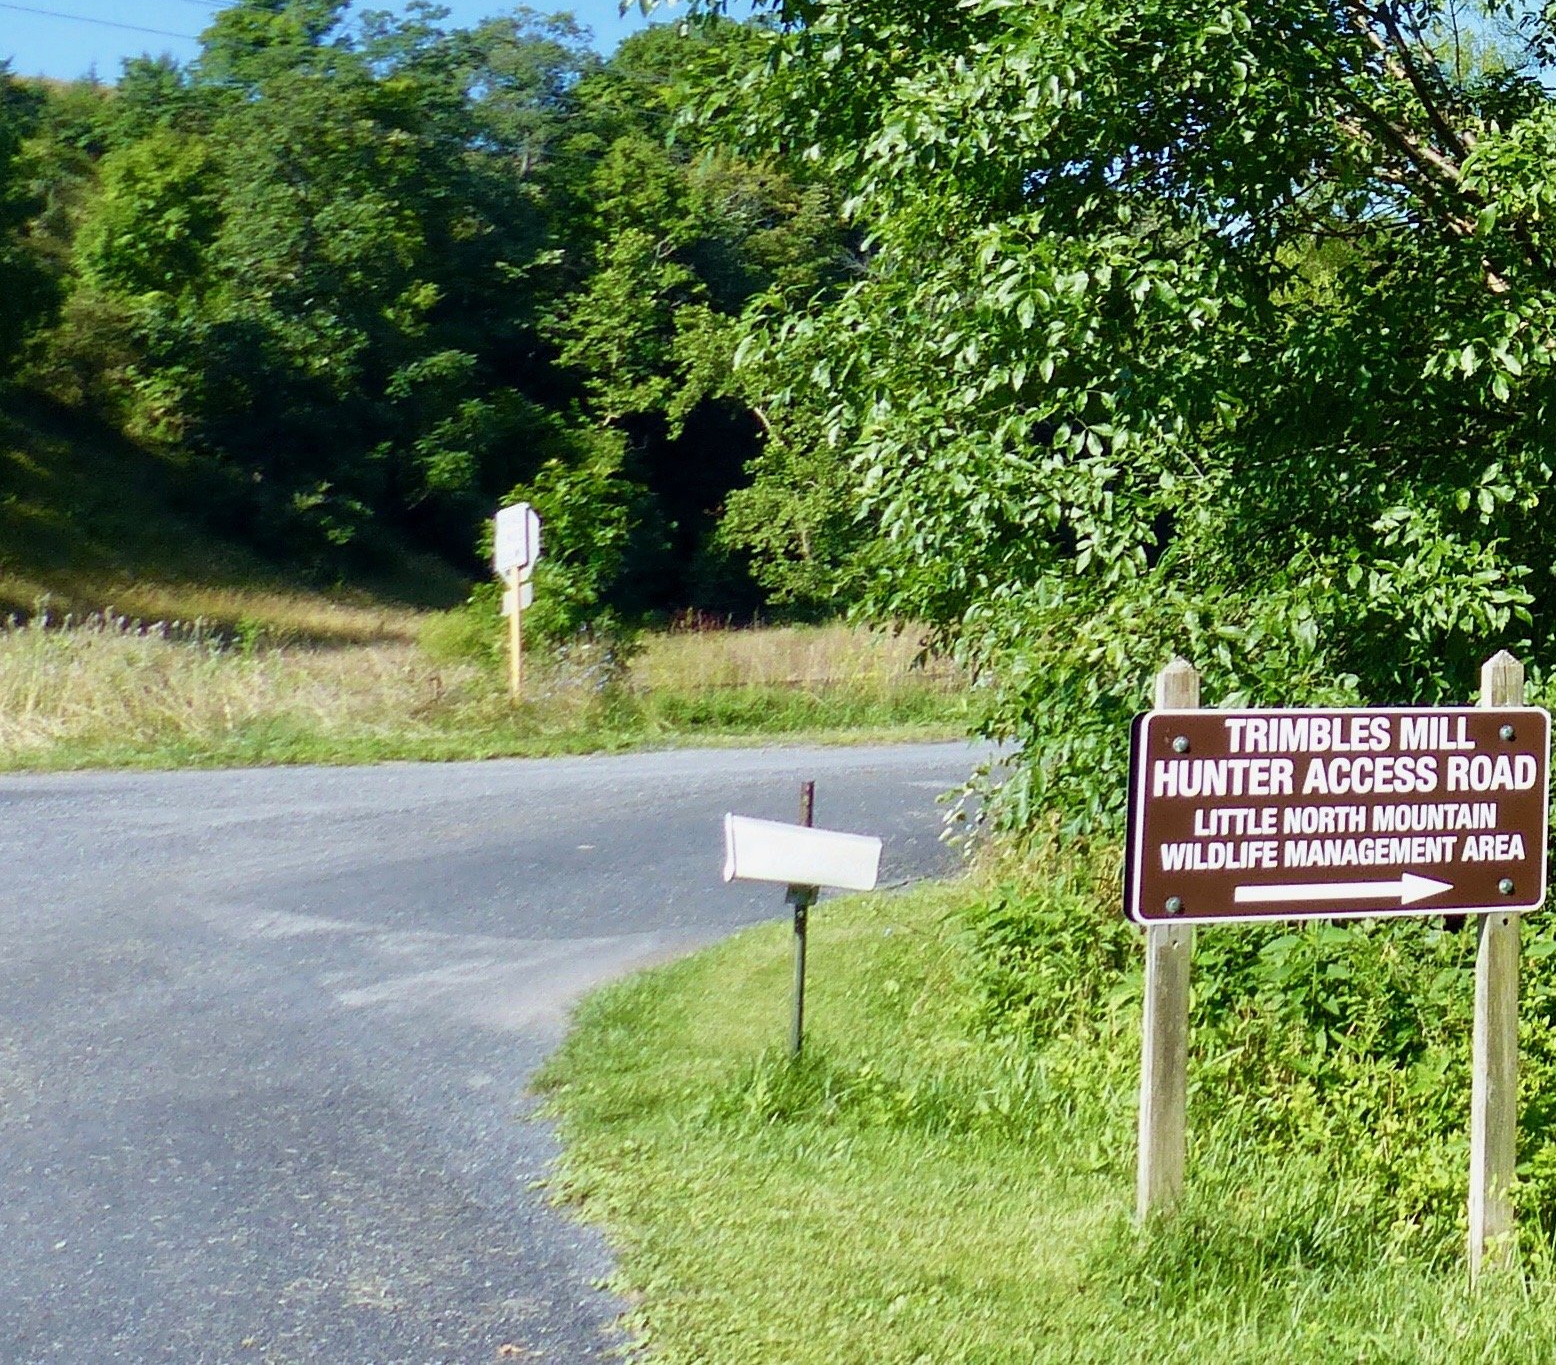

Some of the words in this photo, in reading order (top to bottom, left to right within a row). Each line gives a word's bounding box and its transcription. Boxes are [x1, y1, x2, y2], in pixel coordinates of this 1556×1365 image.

[1225, 717, 1390, 752] TRIMBLES
[1400, 717, 1475, 750] MILL
[1154, 759, 1293, 797] HUNTER
[1303, 756, 1437, 794] ACCESS
[1447, 755, 1536, 791] ROAD
[1195, 808, 1277, 836] LITTLE
[1284, 806, 1366, 834] NORTH
[1373, 803, 1496, 831] MOUNTAIN
[1161, 841, 1278, 871] WILDLIFE
[1284, 837, 1457, 867] MANAGEMENT
[1462, 835, 1525, 861] AREA
